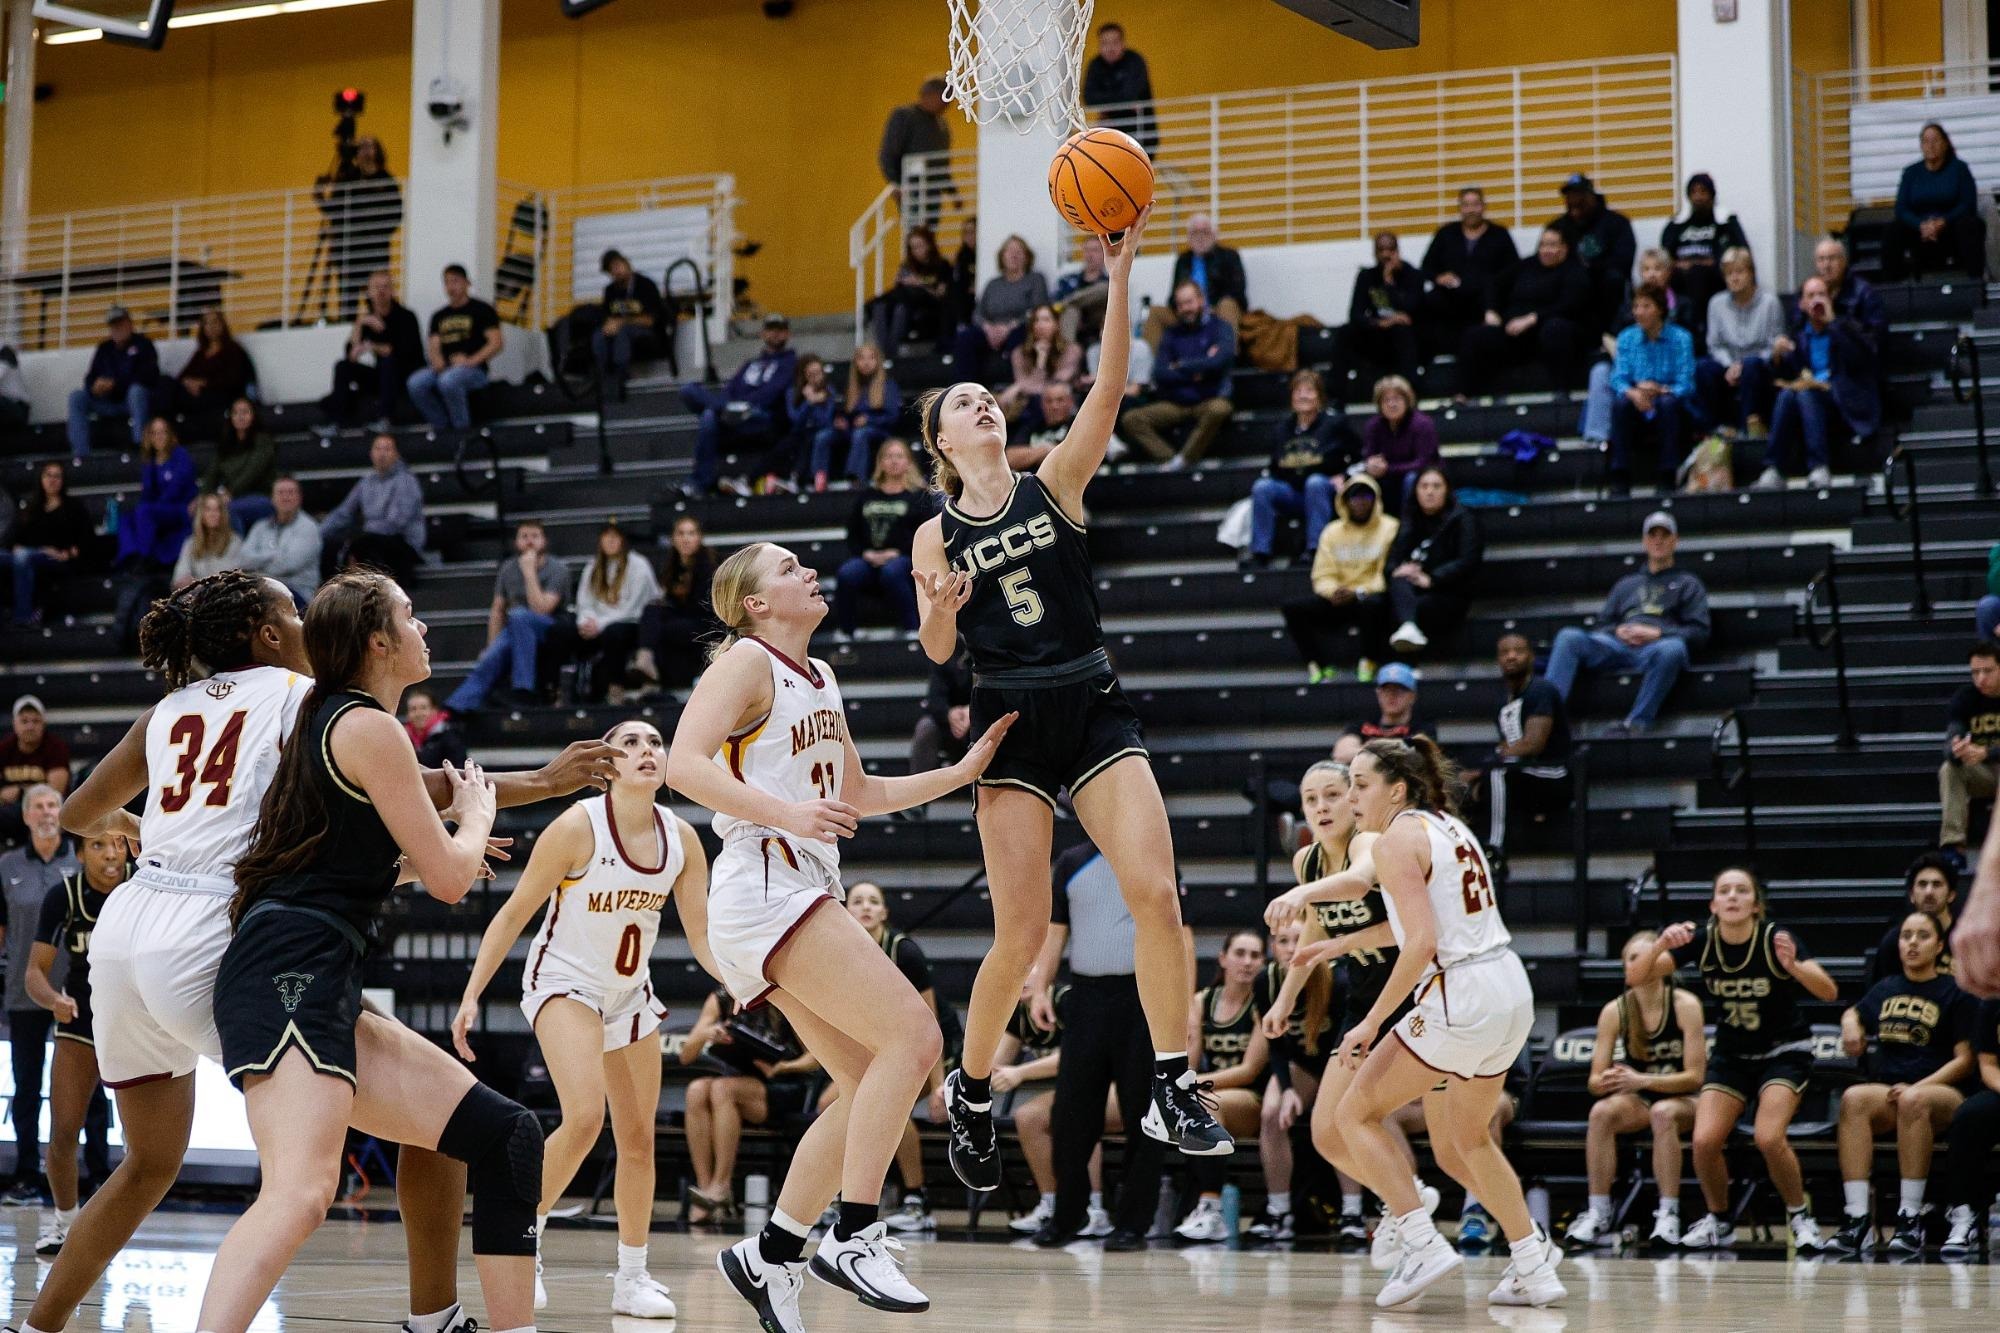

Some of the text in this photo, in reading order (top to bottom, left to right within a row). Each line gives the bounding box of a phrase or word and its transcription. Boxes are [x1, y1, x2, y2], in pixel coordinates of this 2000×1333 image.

[950, 511, 1057, 581] UCCS
[998, 566, 1045, 627] 5
[790, 709, 844, 757] MAVERIC
[160, 709, 248, 813] 34
[588, 889, 669, 912] MAVERIC
[615, 923, 642, 977] 0
[1706, 977, 1771, 998] UCCS
[1879, 994, 1939, 1028] UCCS
